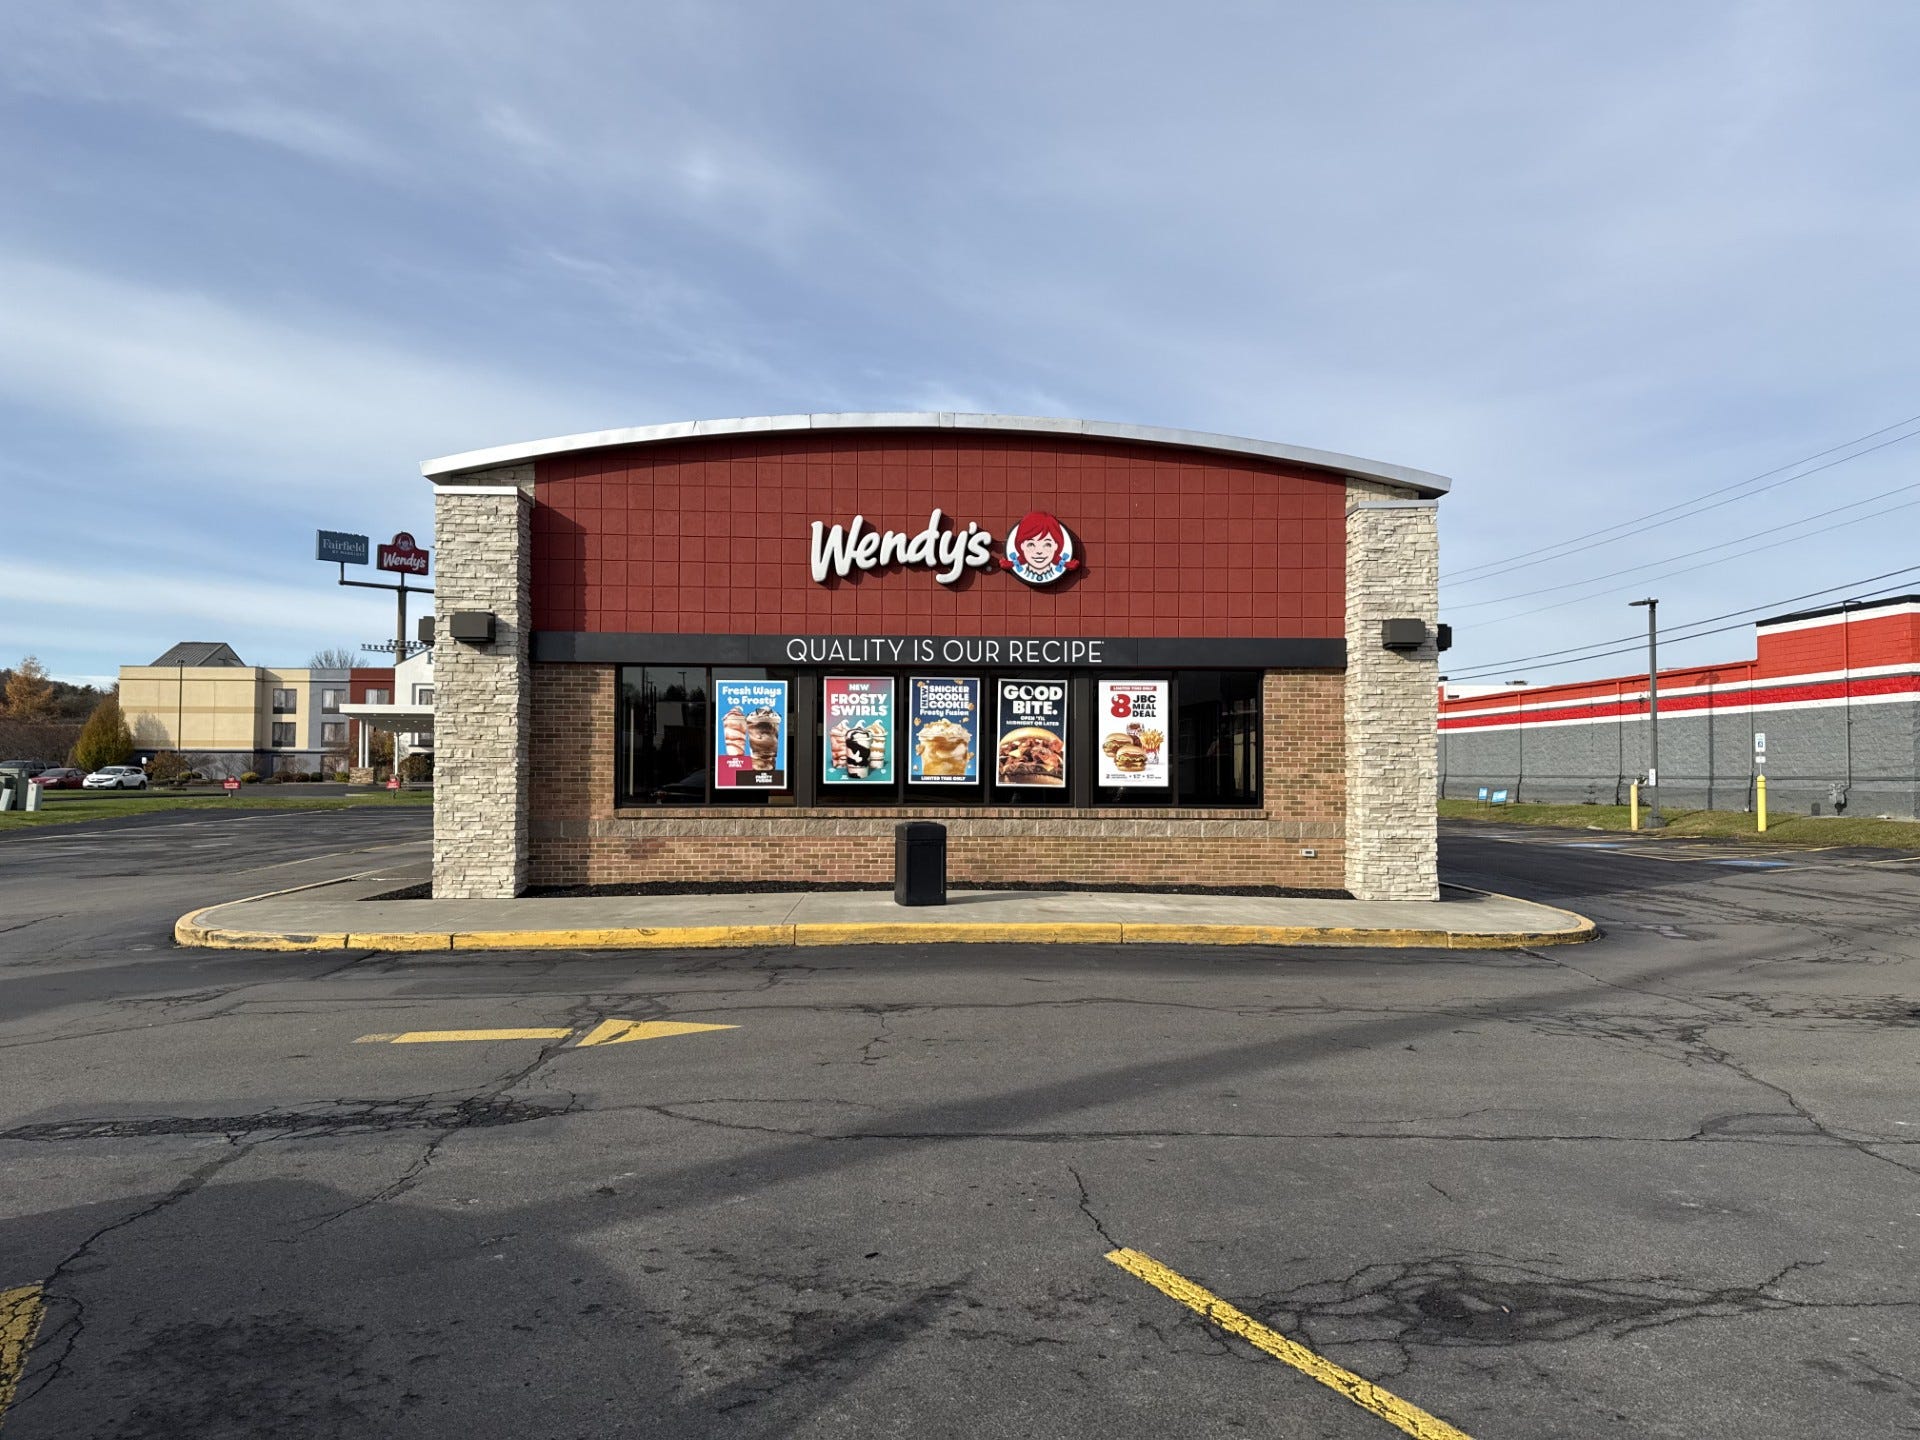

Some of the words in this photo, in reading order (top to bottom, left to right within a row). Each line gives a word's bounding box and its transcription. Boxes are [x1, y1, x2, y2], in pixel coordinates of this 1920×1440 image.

[323, 538, 365, 552] Fairfield
[811, 508, 992, 584] Wendy's
[383, 552, 427, 571] Wendy's
[786, 638, 905, 663] QUALITY
[914, 639, 935, 662] IS
[943, 639, 1000, 663] OUR
[1009, 640, 1103, 664] RECIPE
[722, 686, 751, 695] Fresh
[753, 686, 782, 697] Ways
[929, 685, 970, 693] SNICKER
[1003, 685, 1063, 700] GOOD
[727, 697, 740, 705] to
[741, 696, 776, 707] Frosty
[830, 693, 888, 705] FROSTY
[929, 693, 970, 701] DOODLE
[1133, 695, 1156, 703] JBC
[831, 705, 889, 716] SWIRLS
[920, 709, 944, 717] Frosty
[1012, 700, 1058, 715] BITE.
